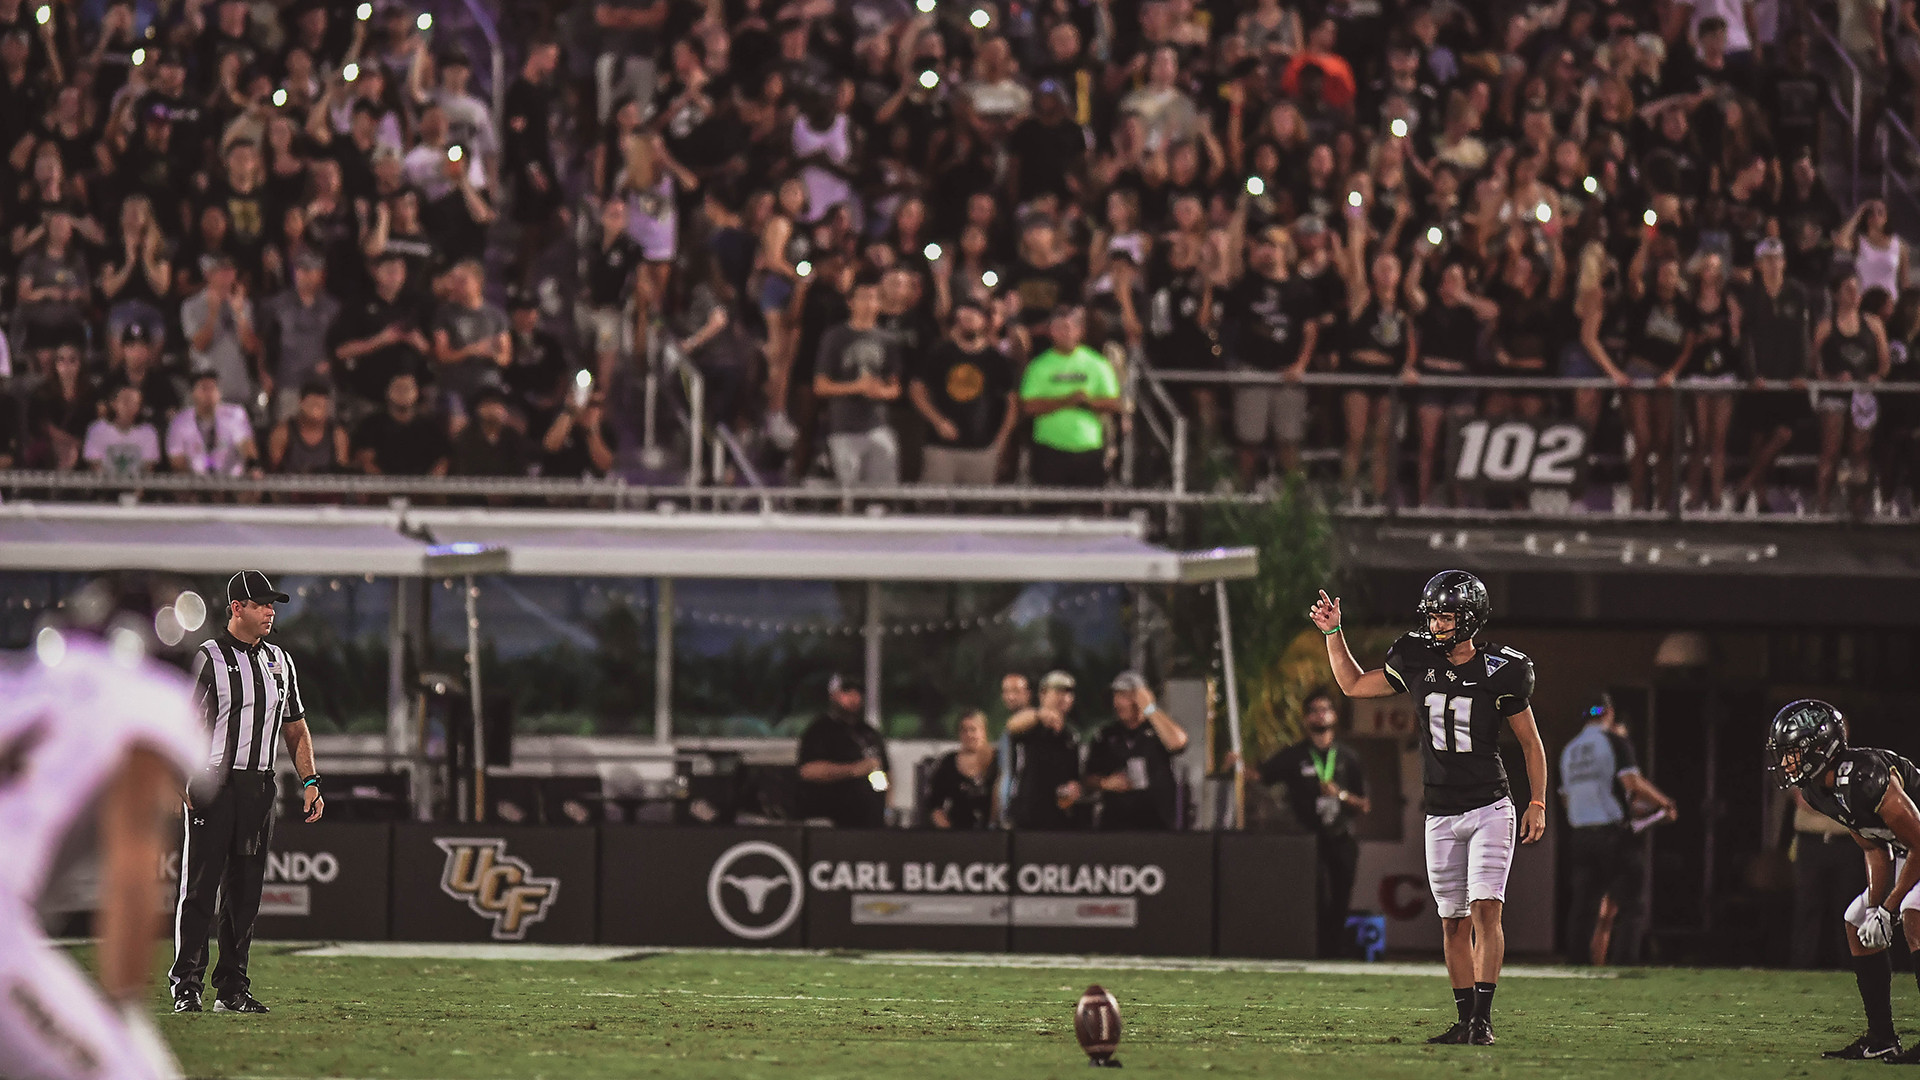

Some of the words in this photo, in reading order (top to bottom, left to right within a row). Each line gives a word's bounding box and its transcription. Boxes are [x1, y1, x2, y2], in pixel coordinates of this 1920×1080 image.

[1455, 421, 1586, 484] 102
[1424, 691, 1473, 753] 11
[265, 852, 339, 883] NDO
[434, 838, 559, 939] UCF
[809, 860, 895, 891] CARL
[902, 861, 1010, 892] BLACK
[1017, 864, 1166, 896] ORLANDO
